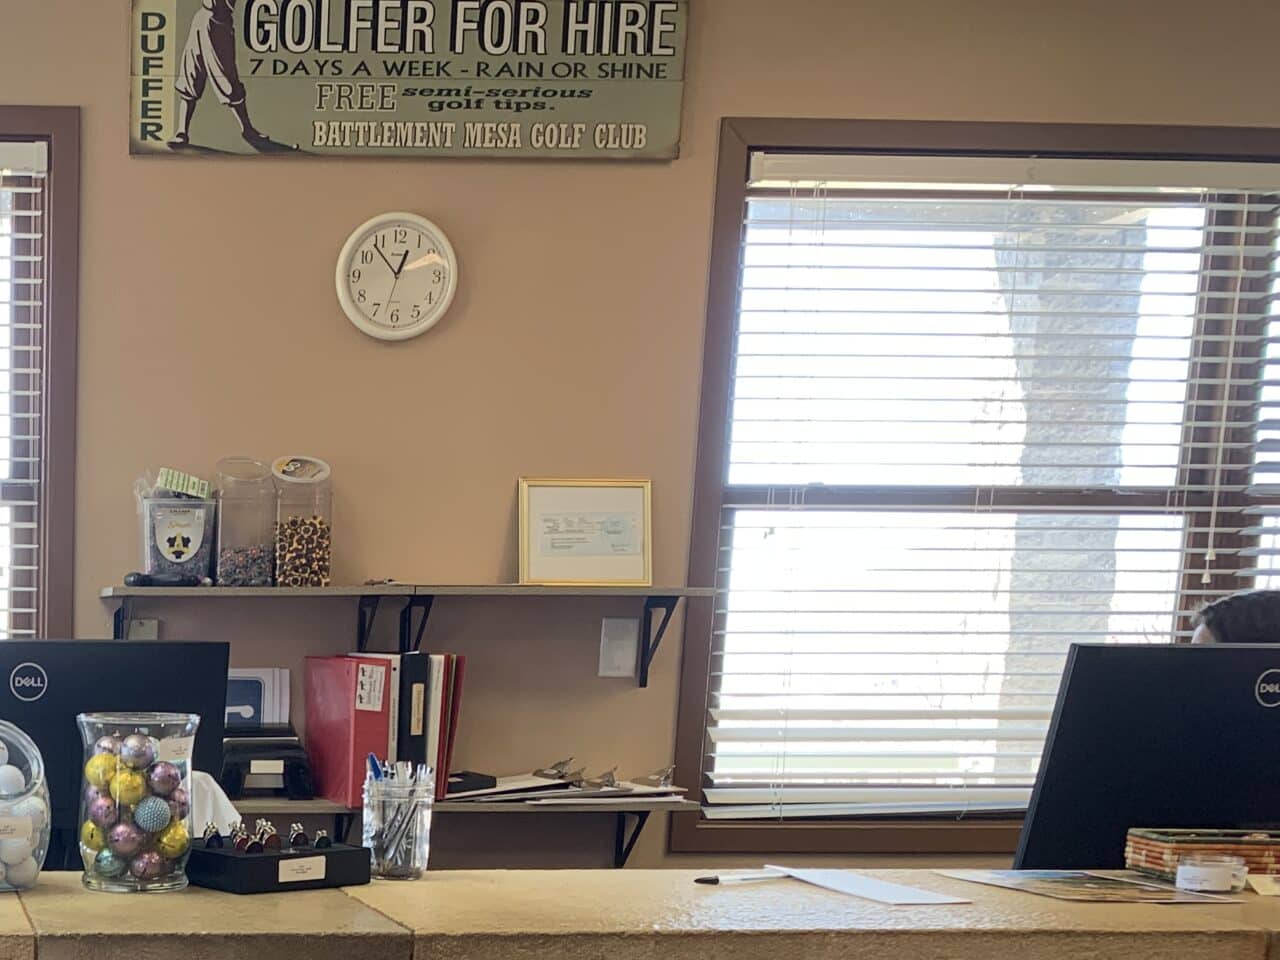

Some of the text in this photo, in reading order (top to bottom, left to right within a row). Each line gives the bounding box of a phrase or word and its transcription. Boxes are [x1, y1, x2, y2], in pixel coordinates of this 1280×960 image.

[244, 0, 679, 57] GOLFER FOR HIRE
[250, 59, 264, 75] 7
[272, 60, 342, 76] DAYS
[352, 60, 371, 76] A
[382, 60, 452, 77] WEEK
[476, 61, 544, 78] RAIN
[552, 62, 589, 78] OR
[597, 62, 668, 79] SHINE
[140, 12, 167, 141] DUFFER
[315, 83, 593, 111] FREE semi-serious
[428, 98, 555, 112] golf tips.
[312, 120, 647, 149] BATTLEMENT MESA GOLF CLUB
[394, 229, 407, 243] 12
[361, 250, 373, 264] 10
[352, 269, 361, 283] 9
[432, 270, 441, 284] 3
[357, 289, 366, 303] 8
[372, 302, 381, 317] 7
[390, 308, 399, 323] 6
[410, 305, 420, 318] 5
[14, 676, 44, 688] DELL
